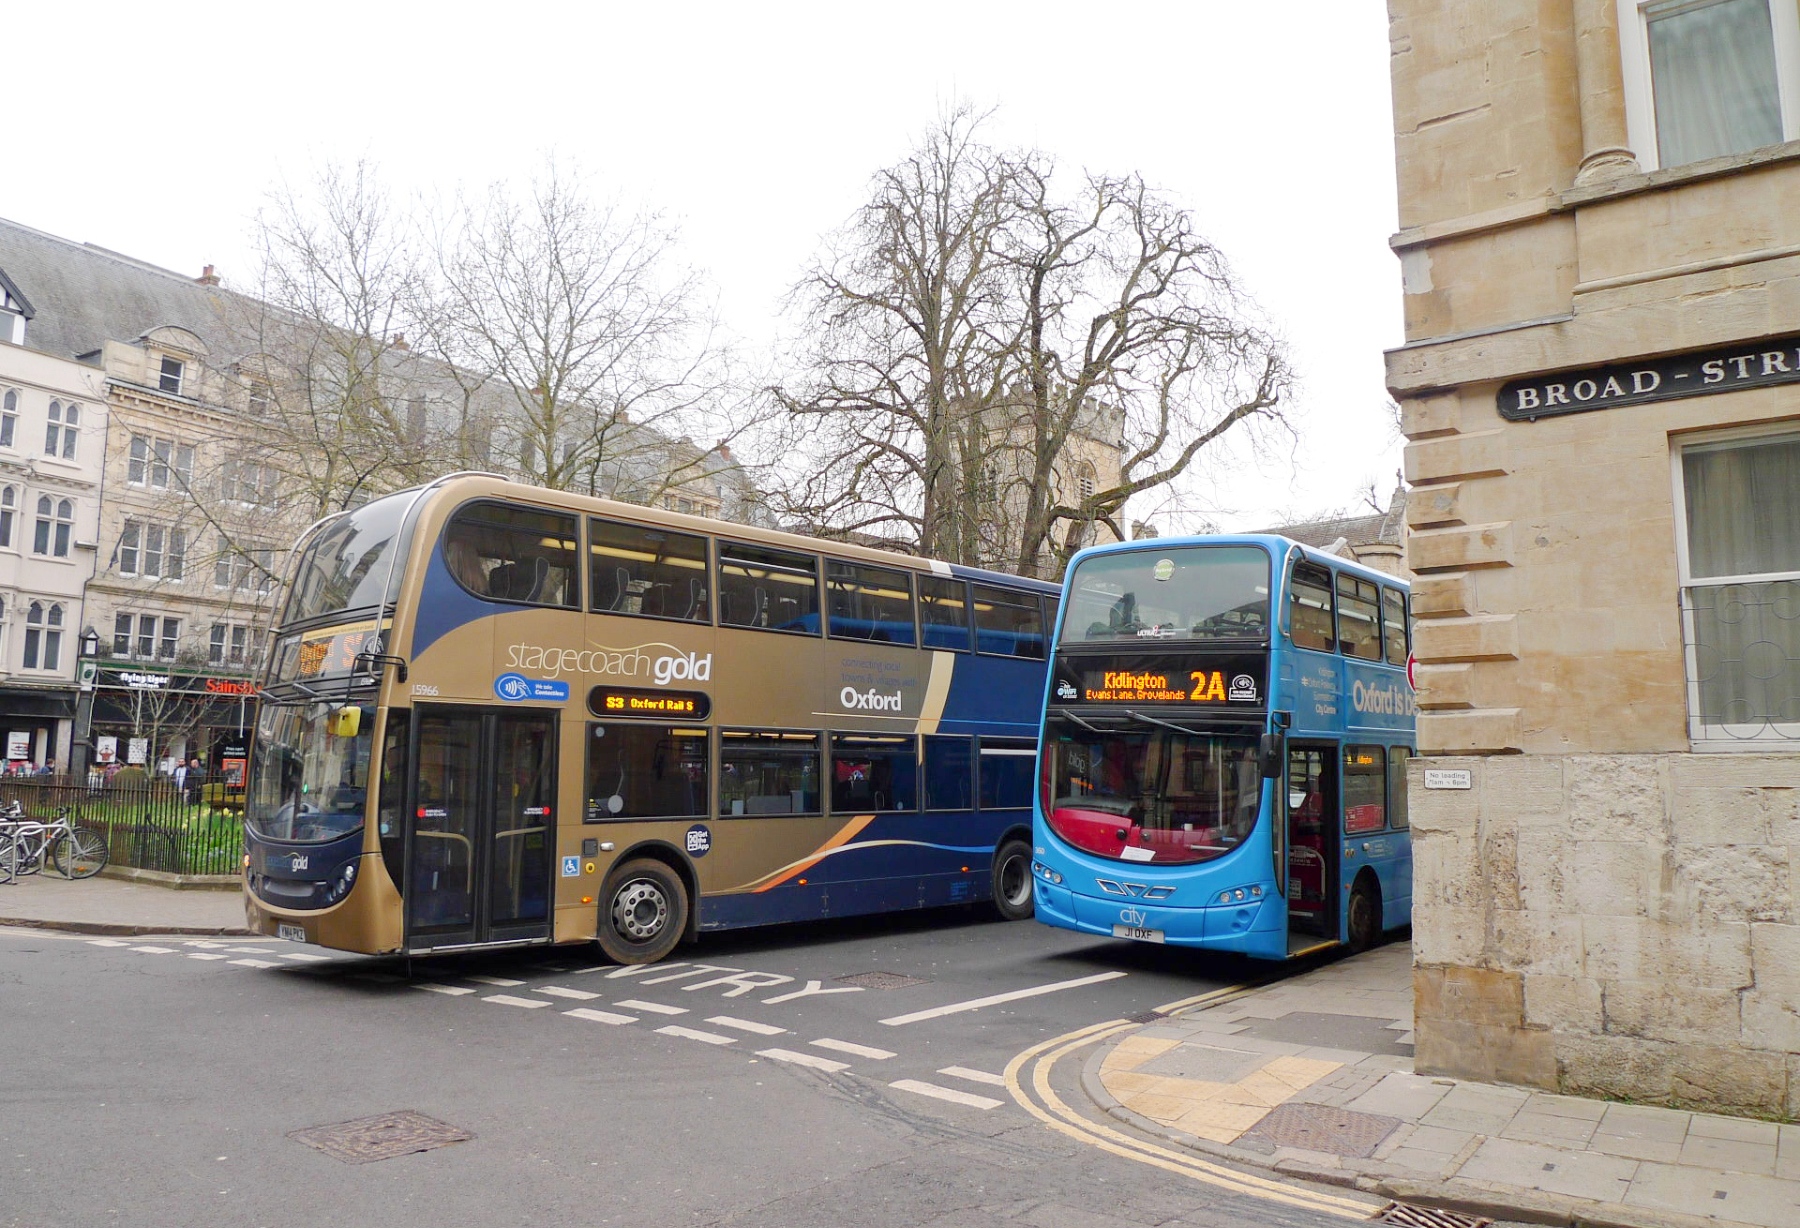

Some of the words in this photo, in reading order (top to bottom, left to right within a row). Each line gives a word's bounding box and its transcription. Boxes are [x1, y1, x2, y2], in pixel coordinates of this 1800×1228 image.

[1517, 370, 1661, 410] BROAD
[506, 642, 650, 679] stagecoach
[654, 652, 712, 685] gold
[120, 672, 146, 683] flying
[147, 674, 169, 684] tiger
[1104, 672, 1167, 689] Kidlington
[1190, 672, 1225, 700] 2A
[412, 684, 439, 696] 15966
[841, 686, 902, 711] Oxford
[1086, 690, 1111, 700] Evans
[1137, 690, 1185, 700] Grovelands
[1353, 680, 1392, 714] Oxford
[1395, 685, 1404, 715] is
[606, 696, 624, 709] S3
[630, 698, 665, 710] Oxford
[666, 700, 685, 710] Rail
[686, 701, 694, 711] S
[1441, 772, 1466, 780] loading
[292, 855, 309, 872] gold
[1120, 906, 1146, 928] city
